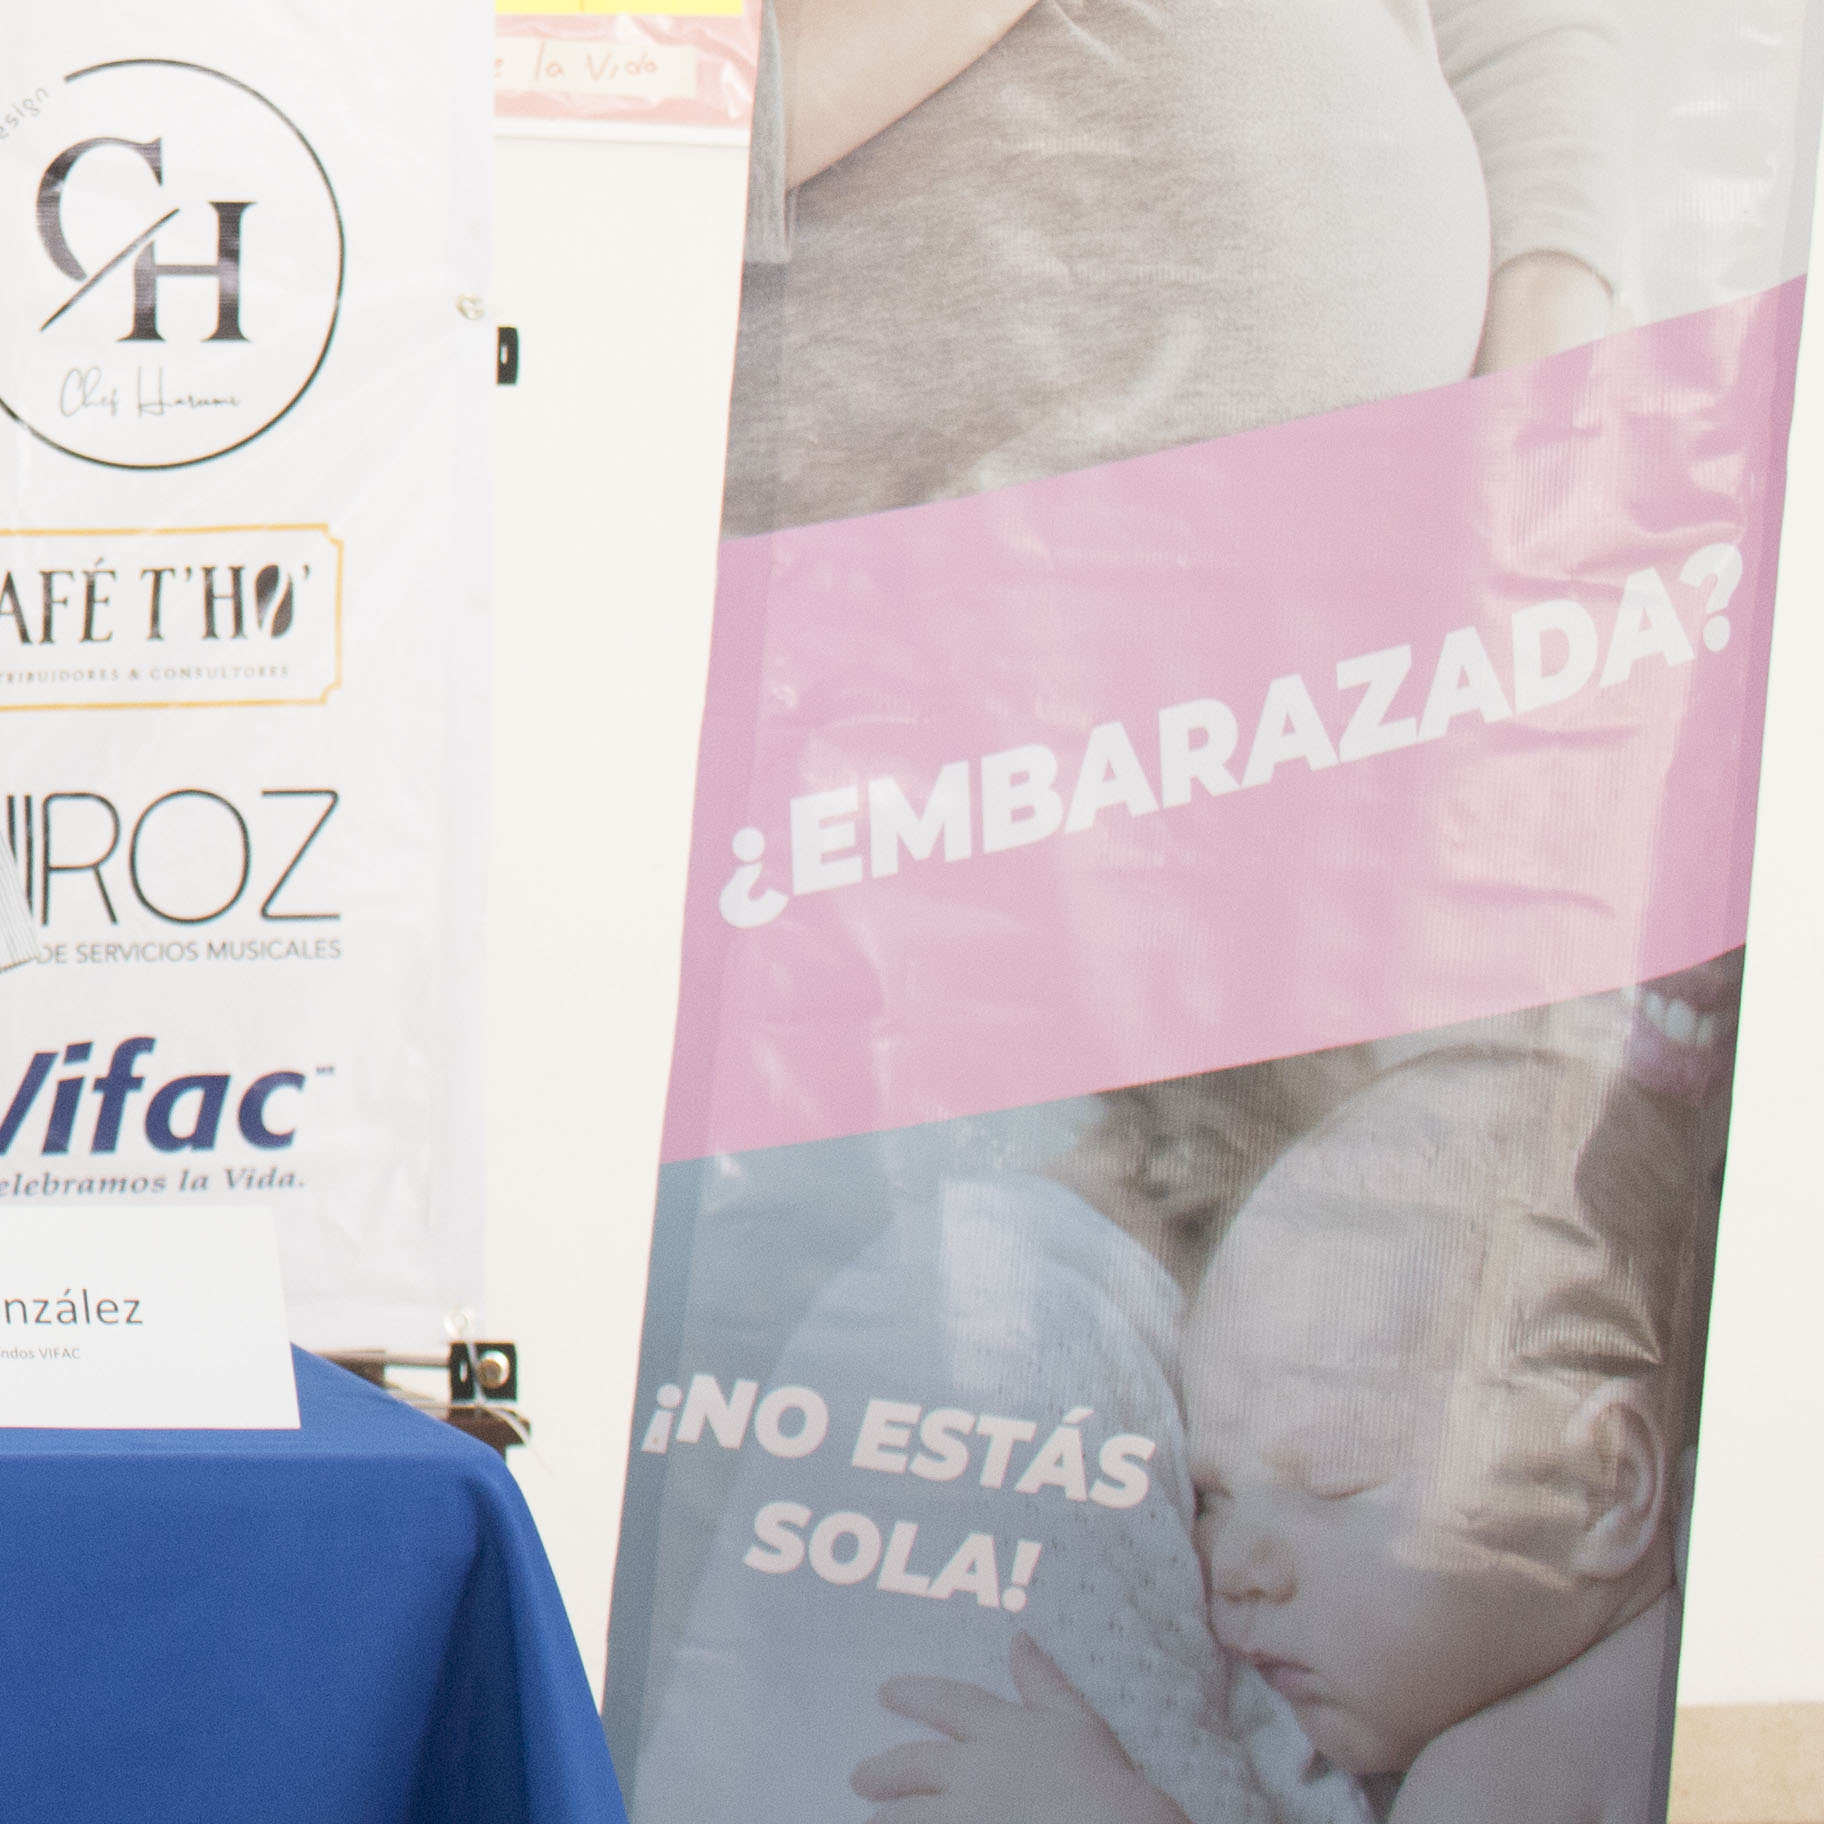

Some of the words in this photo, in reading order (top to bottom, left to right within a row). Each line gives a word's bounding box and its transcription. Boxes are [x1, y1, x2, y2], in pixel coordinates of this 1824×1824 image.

[150, 664, 290, 681] CONSULTORES
[718, 543, 1745, 928] ¿EMBARAZADA?
[77, 942, 198, 963] SERVICIOS
[207, 940, 340, 962] MUSICALES
[180, 1169, 208, 1191] la
[225, 1167, 305, 1191] Vida.
[39, 1345, 81, 1359] VIFAC
[642, 1373, 827, 1456] ¡NO
[852, 1397, 1154, 1511] ESTÁS
[742, 1501, 1042, 1612] SOLA!
